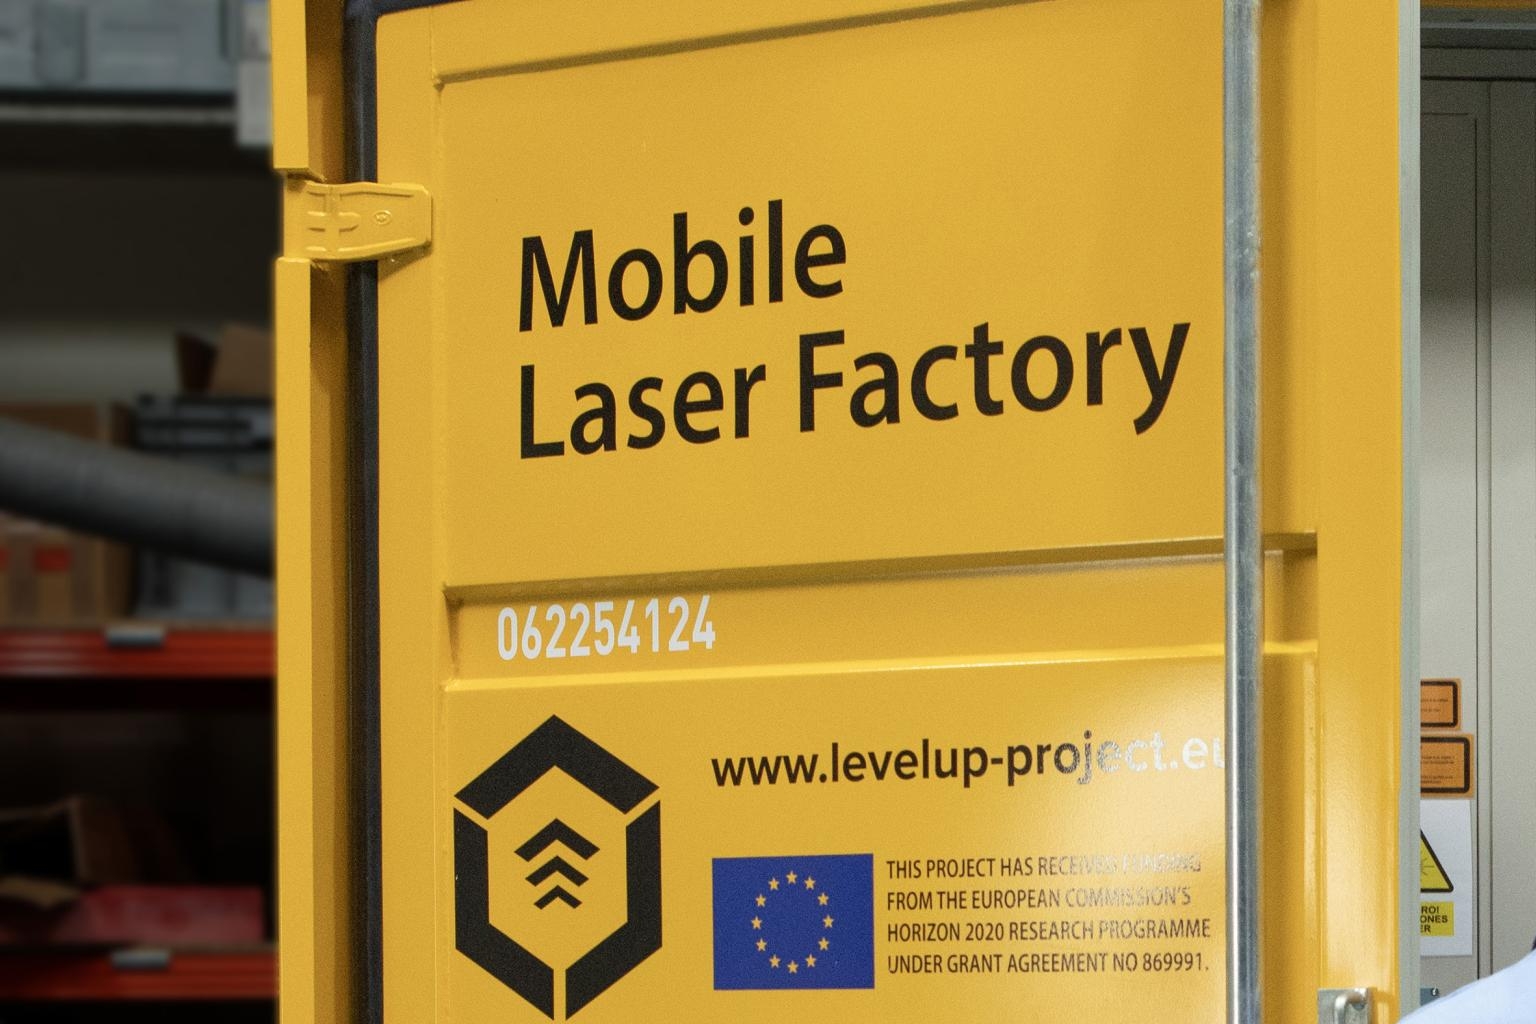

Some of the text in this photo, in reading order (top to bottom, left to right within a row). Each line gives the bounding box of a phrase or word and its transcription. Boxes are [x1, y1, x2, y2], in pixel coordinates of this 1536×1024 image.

[518, 199, 847, 333] Mobile
[519, 322, 1192, 460] Laser Factory
[498, 595, 717, 662] 062254124
[886, 860, 922, 879] THIS
[926, 858, 996, 879] PROJECT
[1000, 857, 1034, 877] HAS
[887, 891, 933, 911] FROM
[937, 890, 967, 910] THE
[972, 888, 1060, 910] EUROPEAN
[887, 918, 1211, 942] HORIZON 2020 RESEARCH PROGRAMME
[887, 951, 1209, 974] UNDER GRANT AGREEMENT NO 869991.
